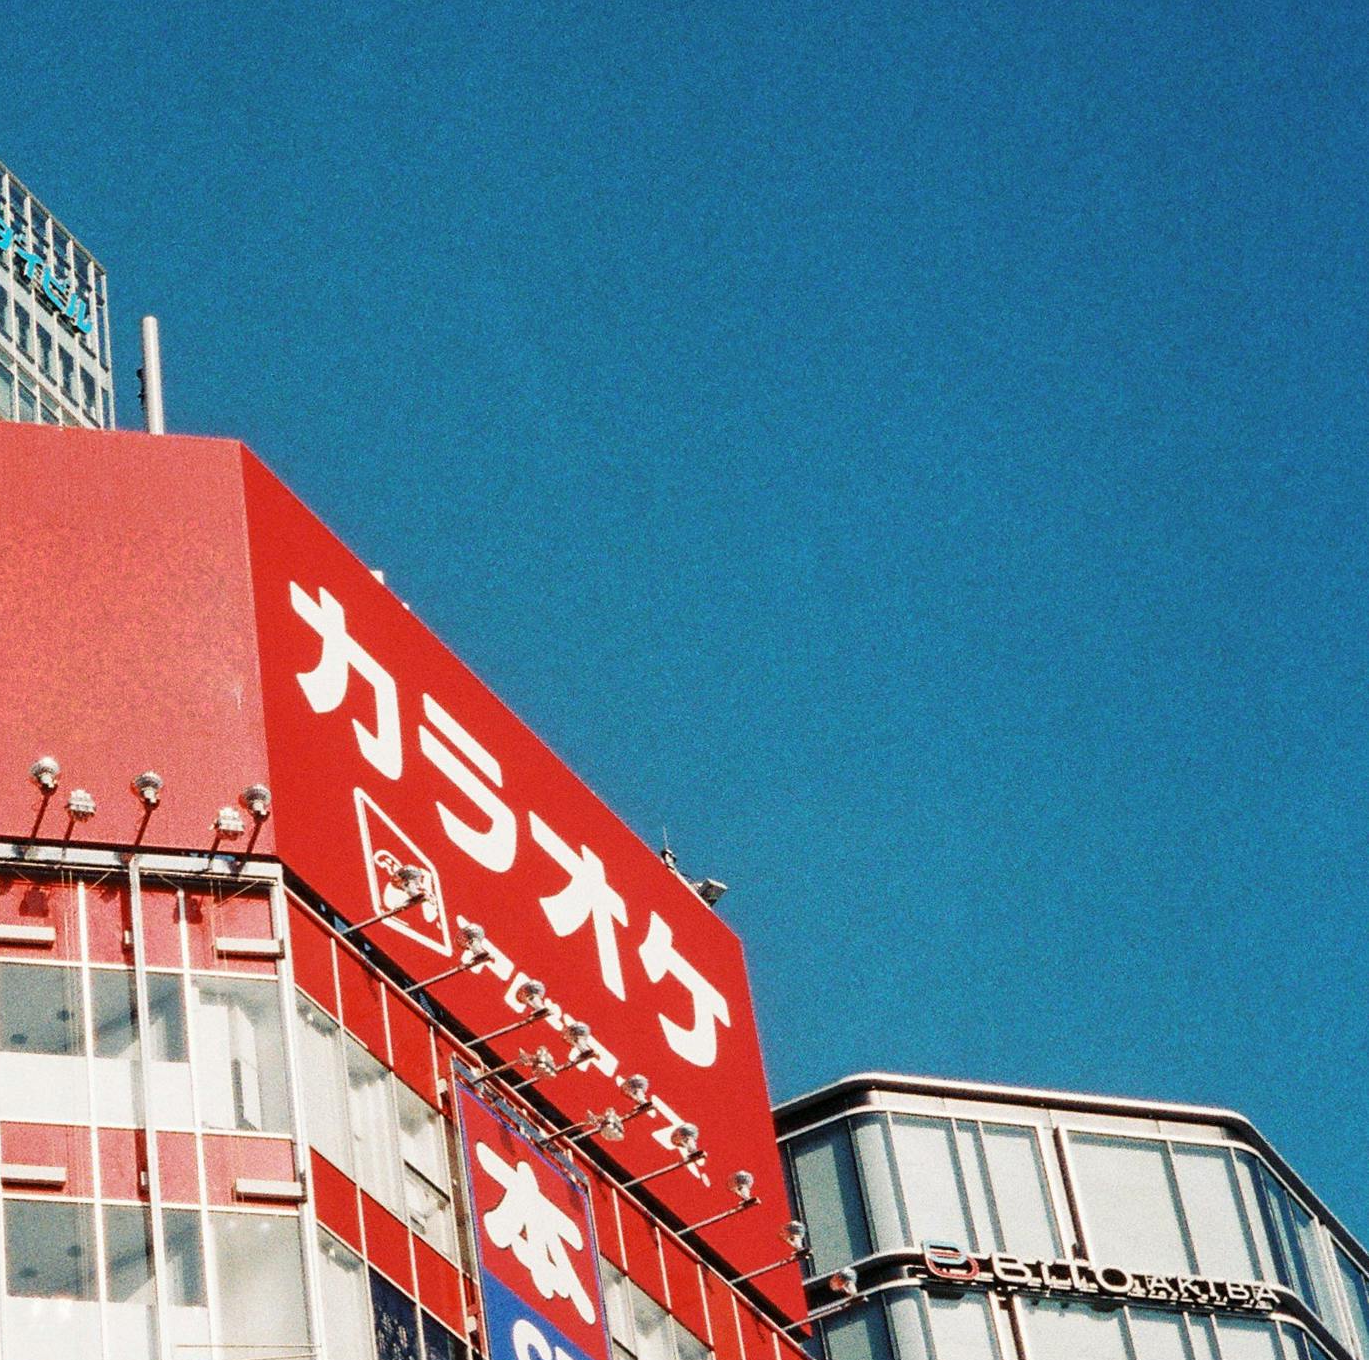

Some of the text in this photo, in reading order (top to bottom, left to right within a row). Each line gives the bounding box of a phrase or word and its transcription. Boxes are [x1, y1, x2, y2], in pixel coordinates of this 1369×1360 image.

[289, 580, 730, 1068] カラオケ
[475, 1141, 595, 1325] 本
[1149, 1274, 1281, 1310] AKIBA
